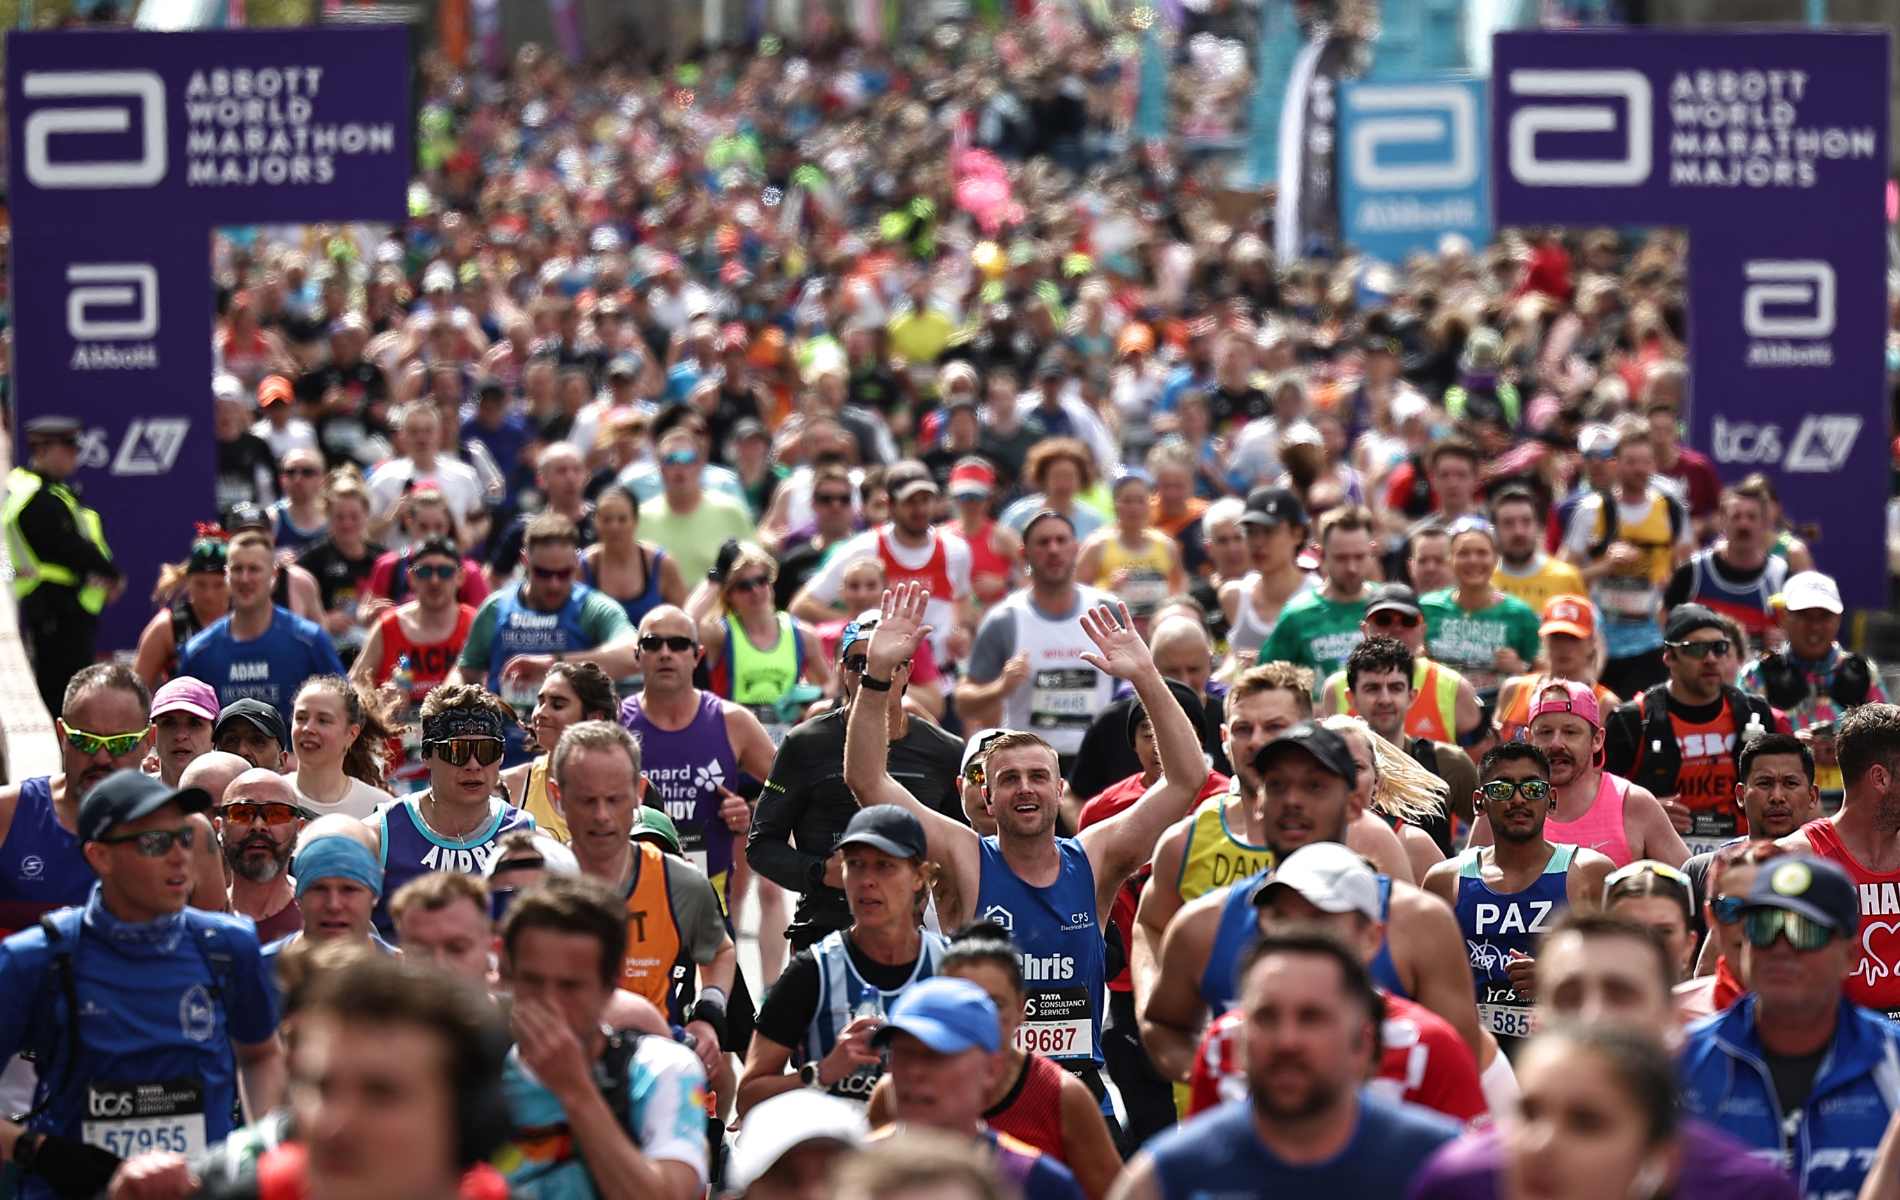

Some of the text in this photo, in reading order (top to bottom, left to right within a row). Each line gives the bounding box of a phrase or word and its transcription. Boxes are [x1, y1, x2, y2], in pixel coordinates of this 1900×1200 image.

[186, 67, 323, 97] ABBOTT
[1669, 69, 1809, 101] ABBOTT
[186, 97, 312, 127] WORLD
[1669, 99, 1797, 130] WORLD
[186, 124, 394, 155] MARATHON
[1670, 127, 1876, 159] MARATHON
[186, 154, 334, 187] MAJORS
[1670, 158, 1818, 188] MAJORS
[72, 343, 160, 370] Abbott
[1747, 342, 1833, 368] Abbott
[1713, 414, 1783, 463] tcs
[230, 662, 269, 681] ADAM
[657, 783, 697, 798] hire
[1071, 912, 1089, 923] CPS
[1476, 901, 1553, 935] PAZ
[1040, 993, 1061, 1001] TATA
[1040, 1000, 1086, 1009] CONSULTANCY
[1040, 1008, 1070, 1016] SERVICES
[1493, 1011, 1534, 1036] 585
[1014, 1028, 1077, 1052] 19687
[89, 1086, 133, 1116] tcs
[104, 1124, 187, 1158] 57955
